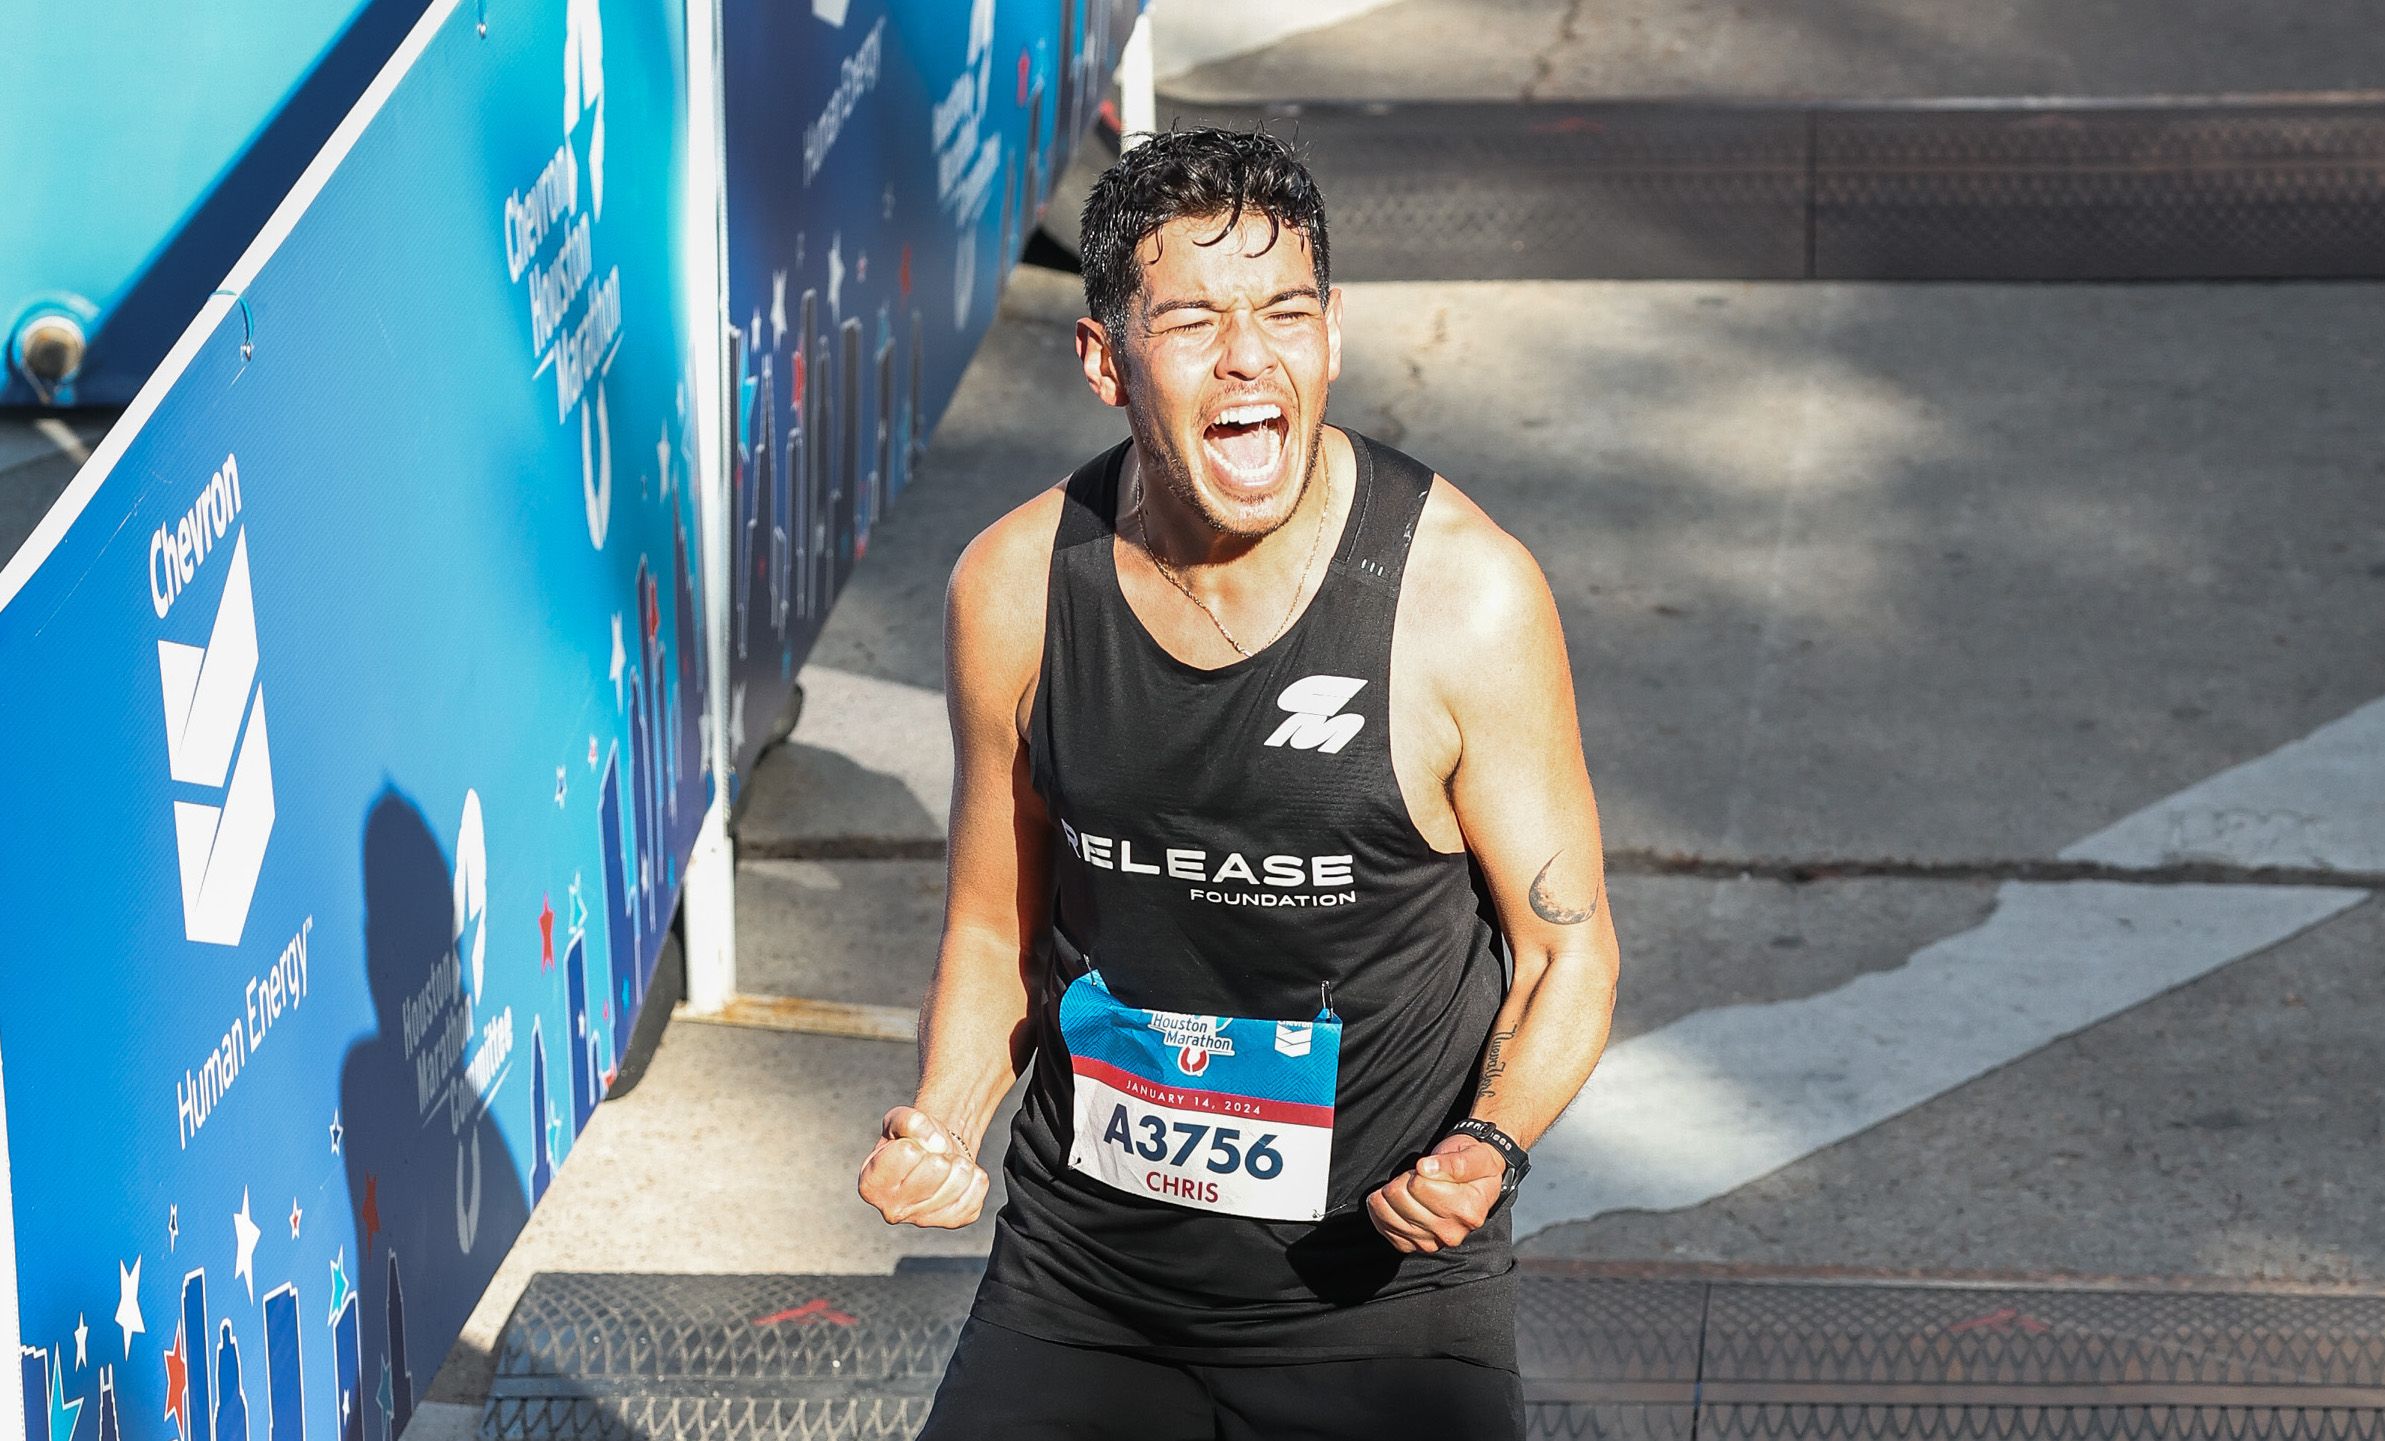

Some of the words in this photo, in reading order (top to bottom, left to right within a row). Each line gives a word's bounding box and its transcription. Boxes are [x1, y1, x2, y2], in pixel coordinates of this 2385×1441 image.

[150, 452, 242, 619] Chevron
[1061, 818, 1354, 887] RELEASE
[1190, 889, 1356, 907] FOUNDATION
[402, 951, 451, 1061] Houston
[1153, 1013, 1208, 1033] Houston
[1166, 1031, 1230, 1050] Marathon
[177, 1017, 245, 1151] Human
[416, 992, 474, 1115] Marathon
[451, 1005, 513, 1135] Committee
[1126, 1080, 1185, 1105] JANUARY
[1194, 1096, 1216, 1109] 14,
[1224, 1101, 1261, 1115] 2024
[1103, 1103, 1284, 1180] A3756
[1146, 1171, 1219, 1203] CHRIS
